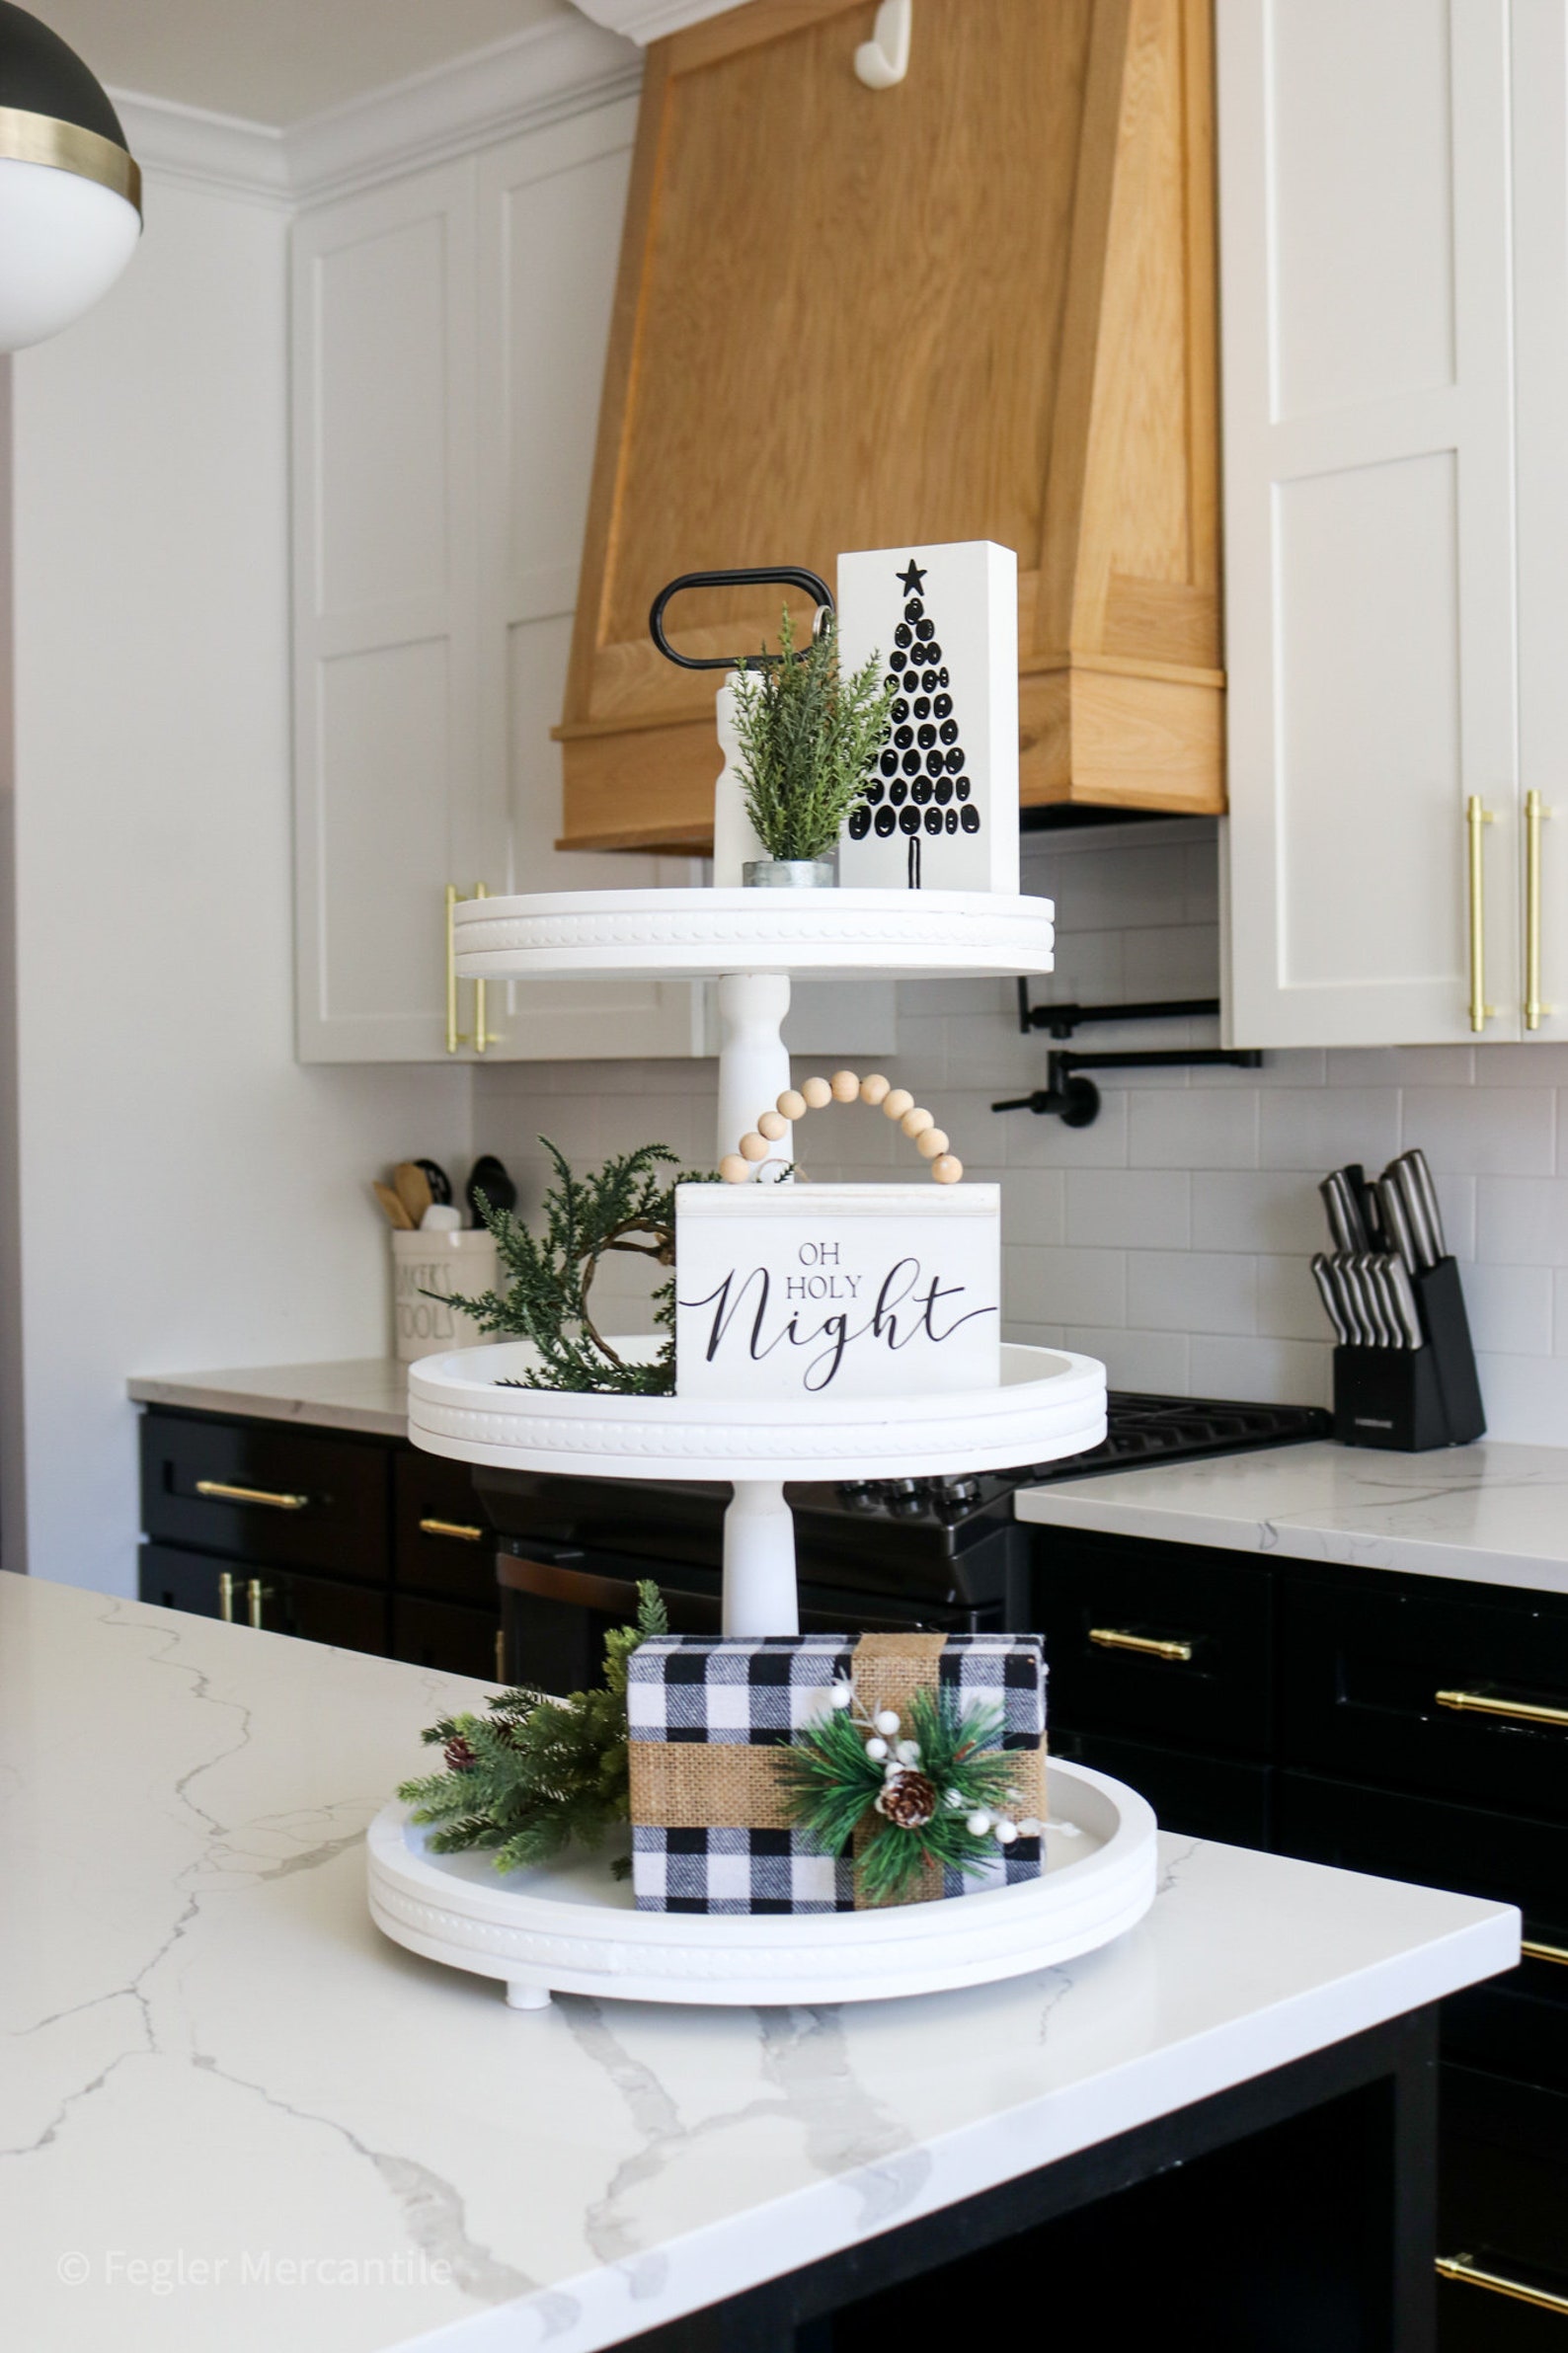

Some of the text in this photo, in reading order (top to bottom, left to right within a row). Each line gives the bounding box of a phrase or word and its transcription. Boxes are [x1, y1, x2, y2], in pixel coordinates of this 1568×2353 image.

[799, 1242, 839, 1266] OH
[786, 1276, 862, 1299] HOLY
[678, 1257, 998, 1391] Night
